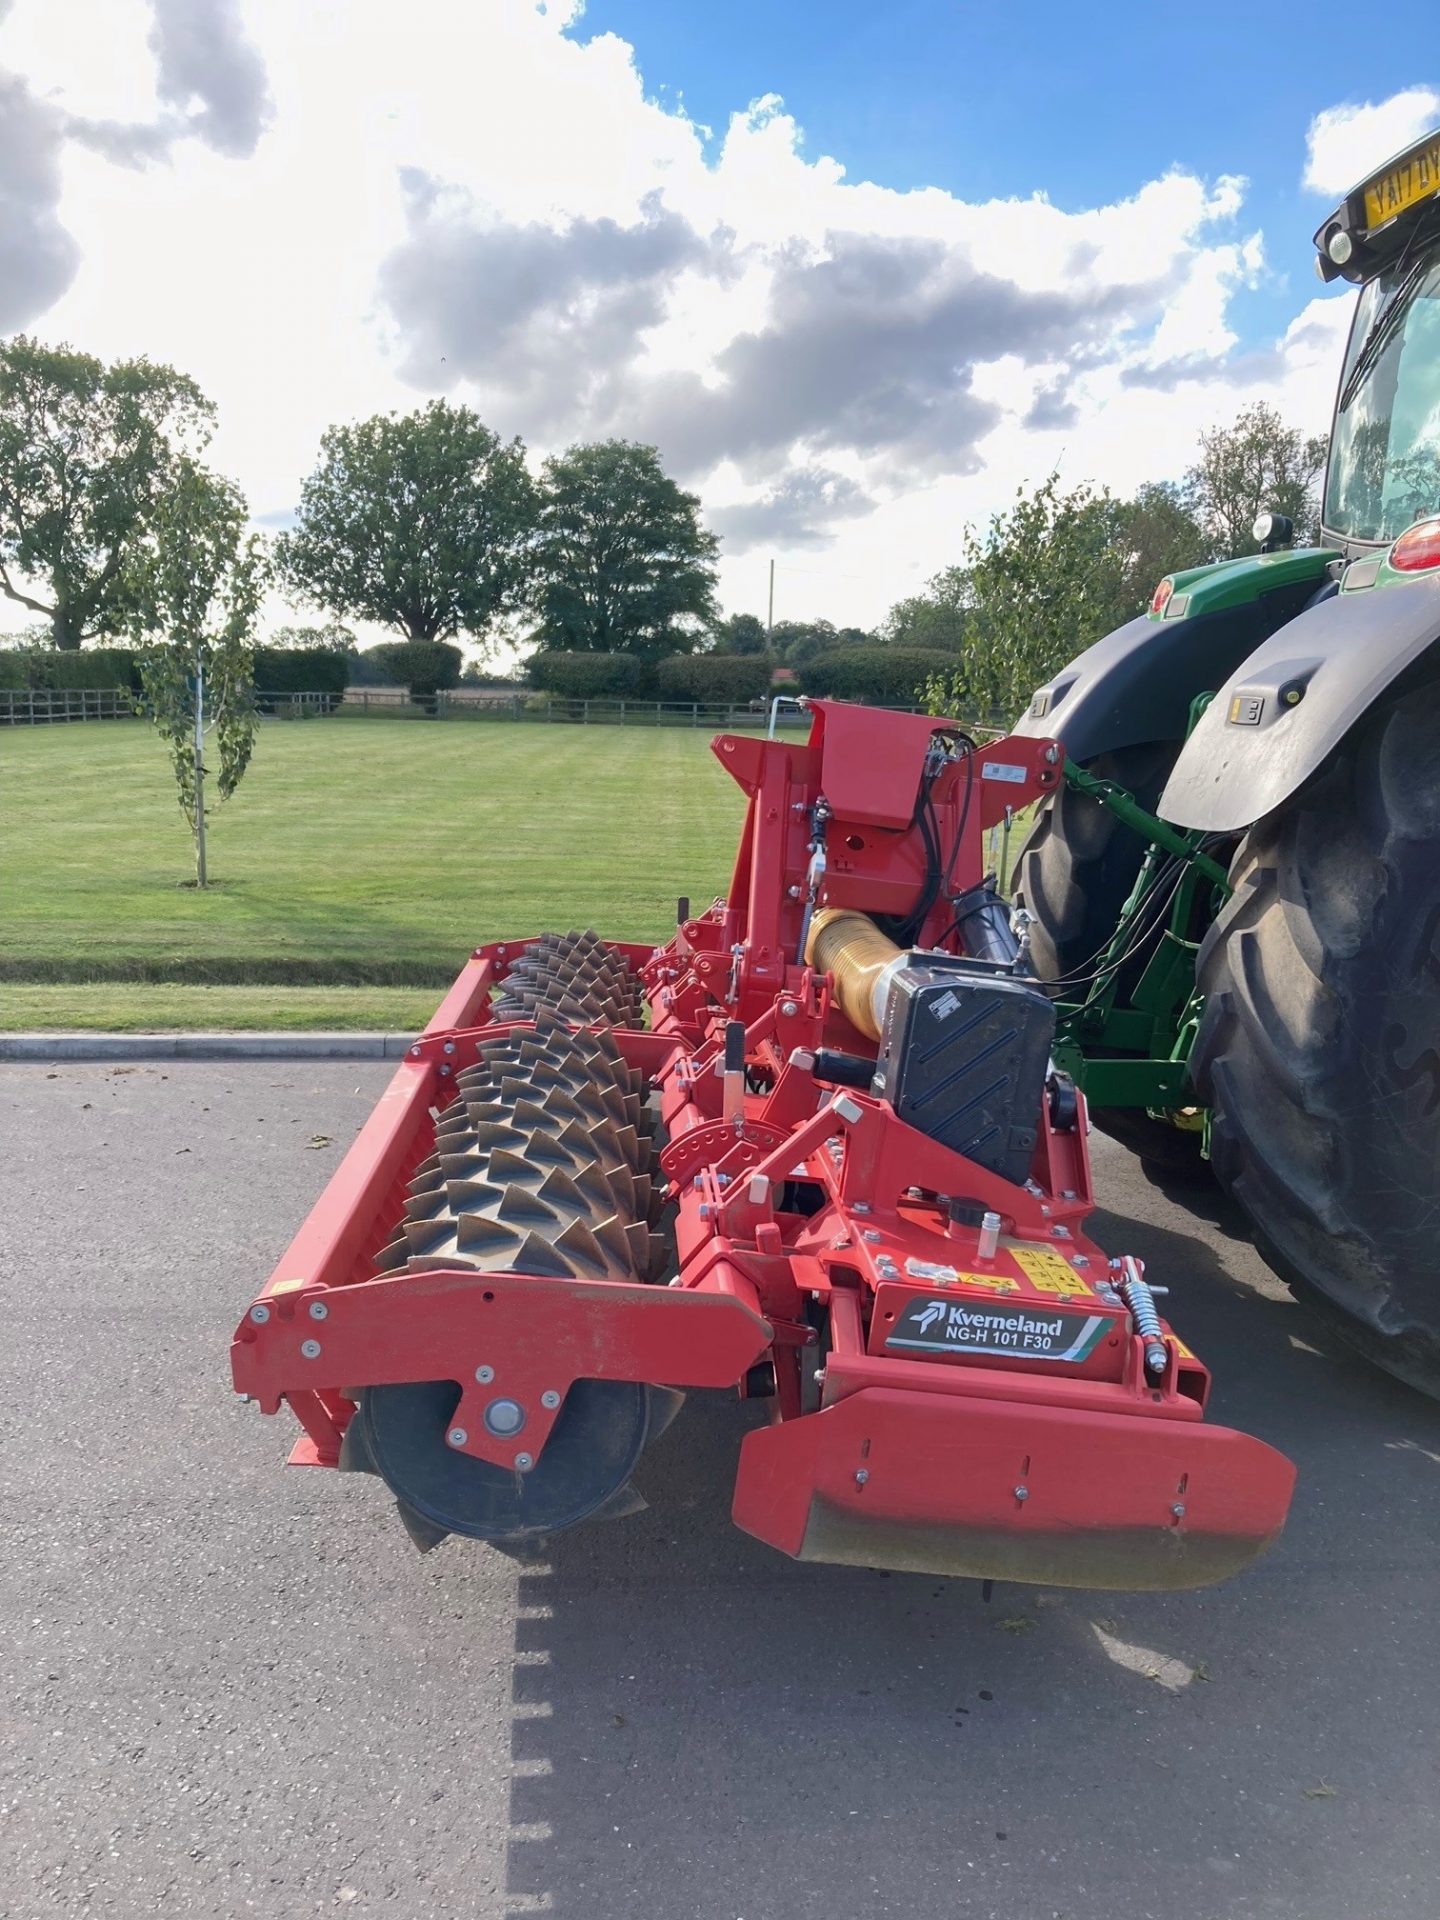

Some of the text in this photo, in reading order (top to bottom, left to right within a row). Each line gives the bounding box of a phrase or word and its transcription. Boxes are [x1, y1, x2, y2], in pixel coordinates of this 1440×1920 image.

[1375, 163, 1411, 214] YA17
[948, 1307, 1063, 1337] Kverneland
[945, 1326, 1052, 1350] NG-H 101 F30
